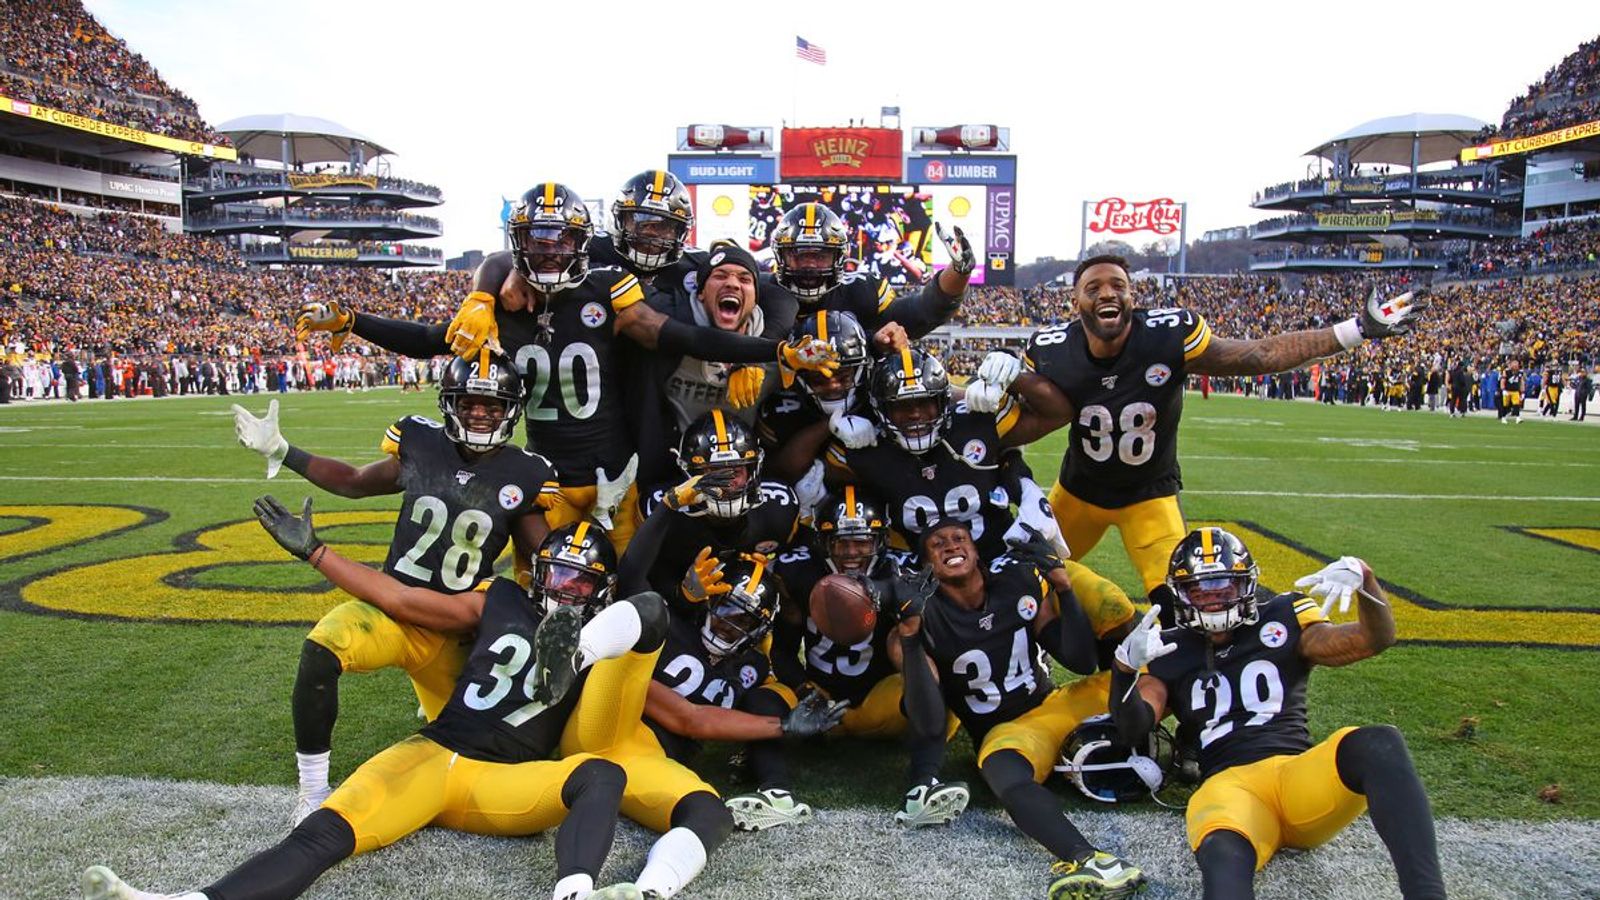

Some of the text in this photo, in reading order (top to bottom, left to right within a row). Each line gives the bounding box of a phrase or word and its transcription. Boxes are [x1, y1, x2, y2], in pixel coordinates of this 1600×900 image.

[35, 107, 50, 119] AT
[52, 111, 101, 133] CURBSIDE
[105, 125, 147, 142] EXPRESS
[1498, 142, 1513, 153] AT
[1514, 131, 1564, 151] CURBSIDE
[813, 137, 869, 157] HEINZ
[690, 166, 754, 177] BUD LIGHT
[926, 163, 998, 180] 84 LUMBER
[995, 192, 1010, 248] UPMC
[469, 361, 498, 380] 28
[515, 342, 600, 421] 20
[1078, 402, 1156, 466] 38
[838, 503, 864, 519] 23
[394, 495, 493, 591] 28
[952, 627, 1037, 714] 34
[1191, 660, 1284, 749] 29
